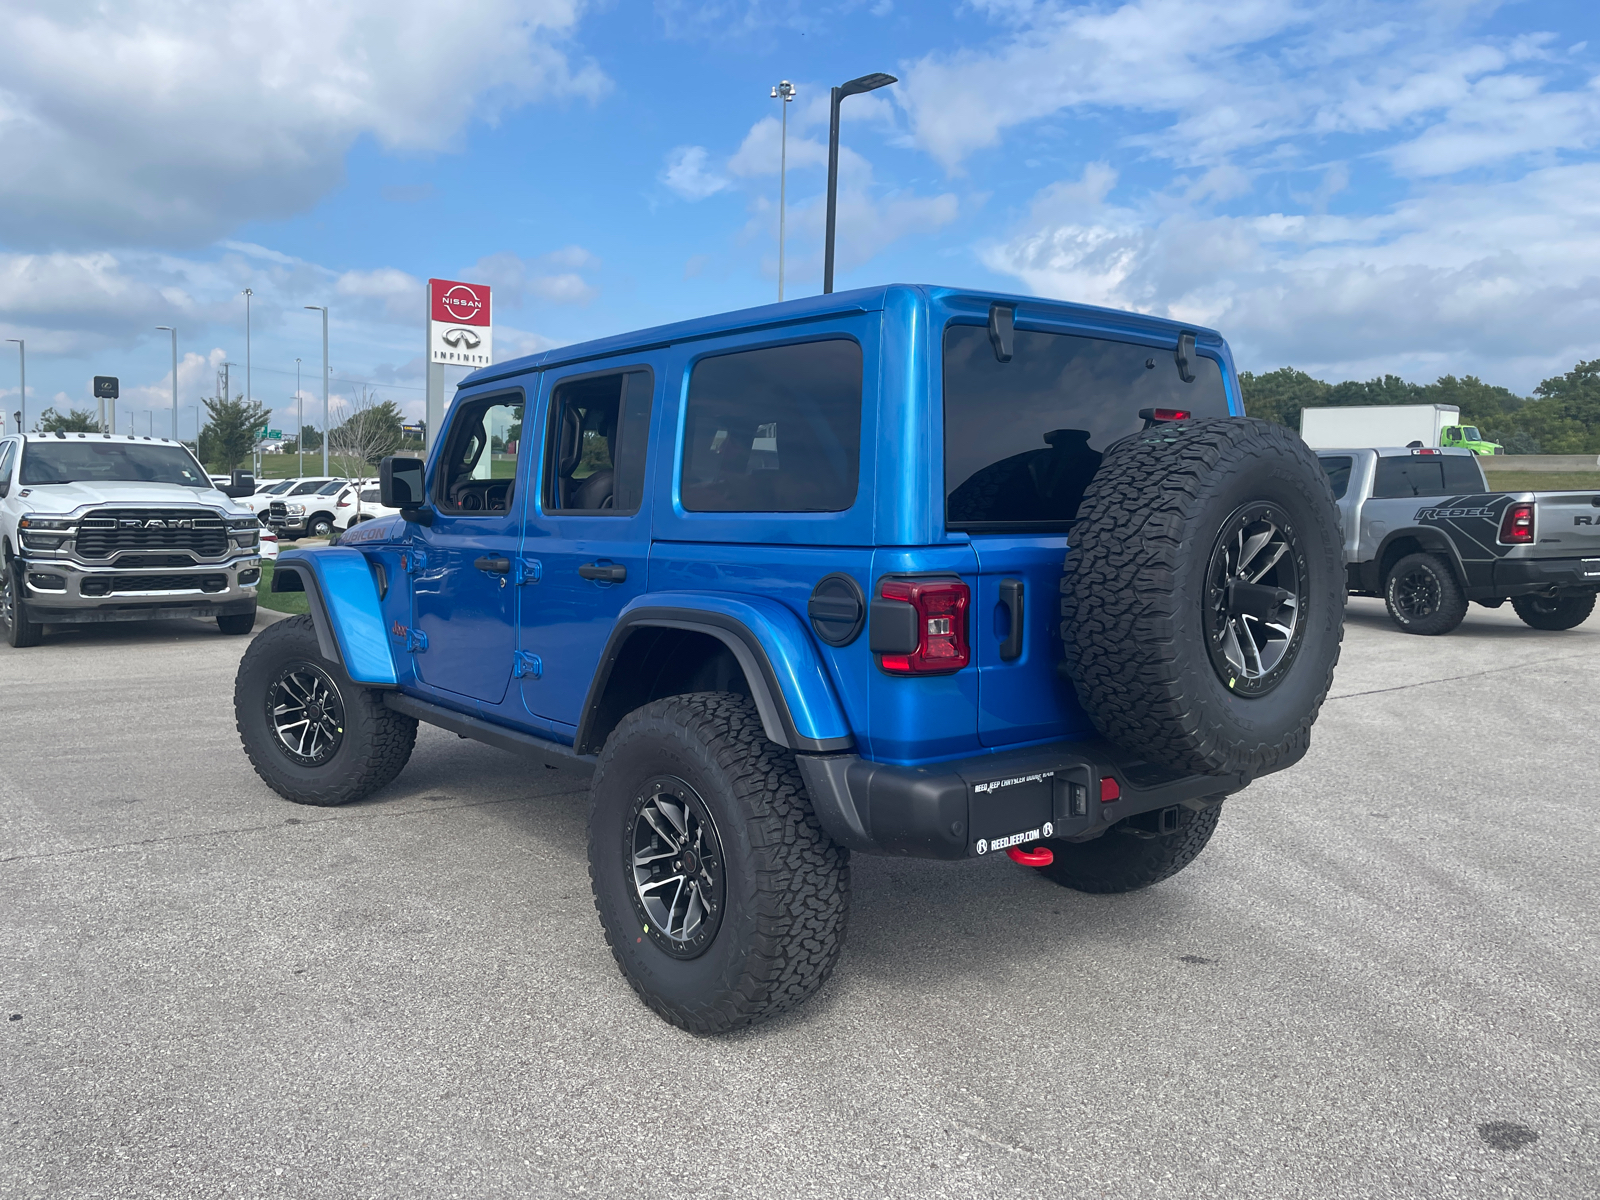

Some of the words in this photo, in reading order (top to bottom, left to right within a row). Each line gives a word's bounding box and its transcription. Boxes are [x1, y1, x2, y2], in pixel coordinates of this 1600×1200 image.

[442, 297, 482, 308] NISSAN
[434, 351, 489, 364] INFINITI
[1413, 507, 1495, 521] REBEL
[119, 519, 191, 529] RAM
[341, 527, 387, 543] RUBICON
[991, 829, 1039, 851] REEDJEEP.COM
